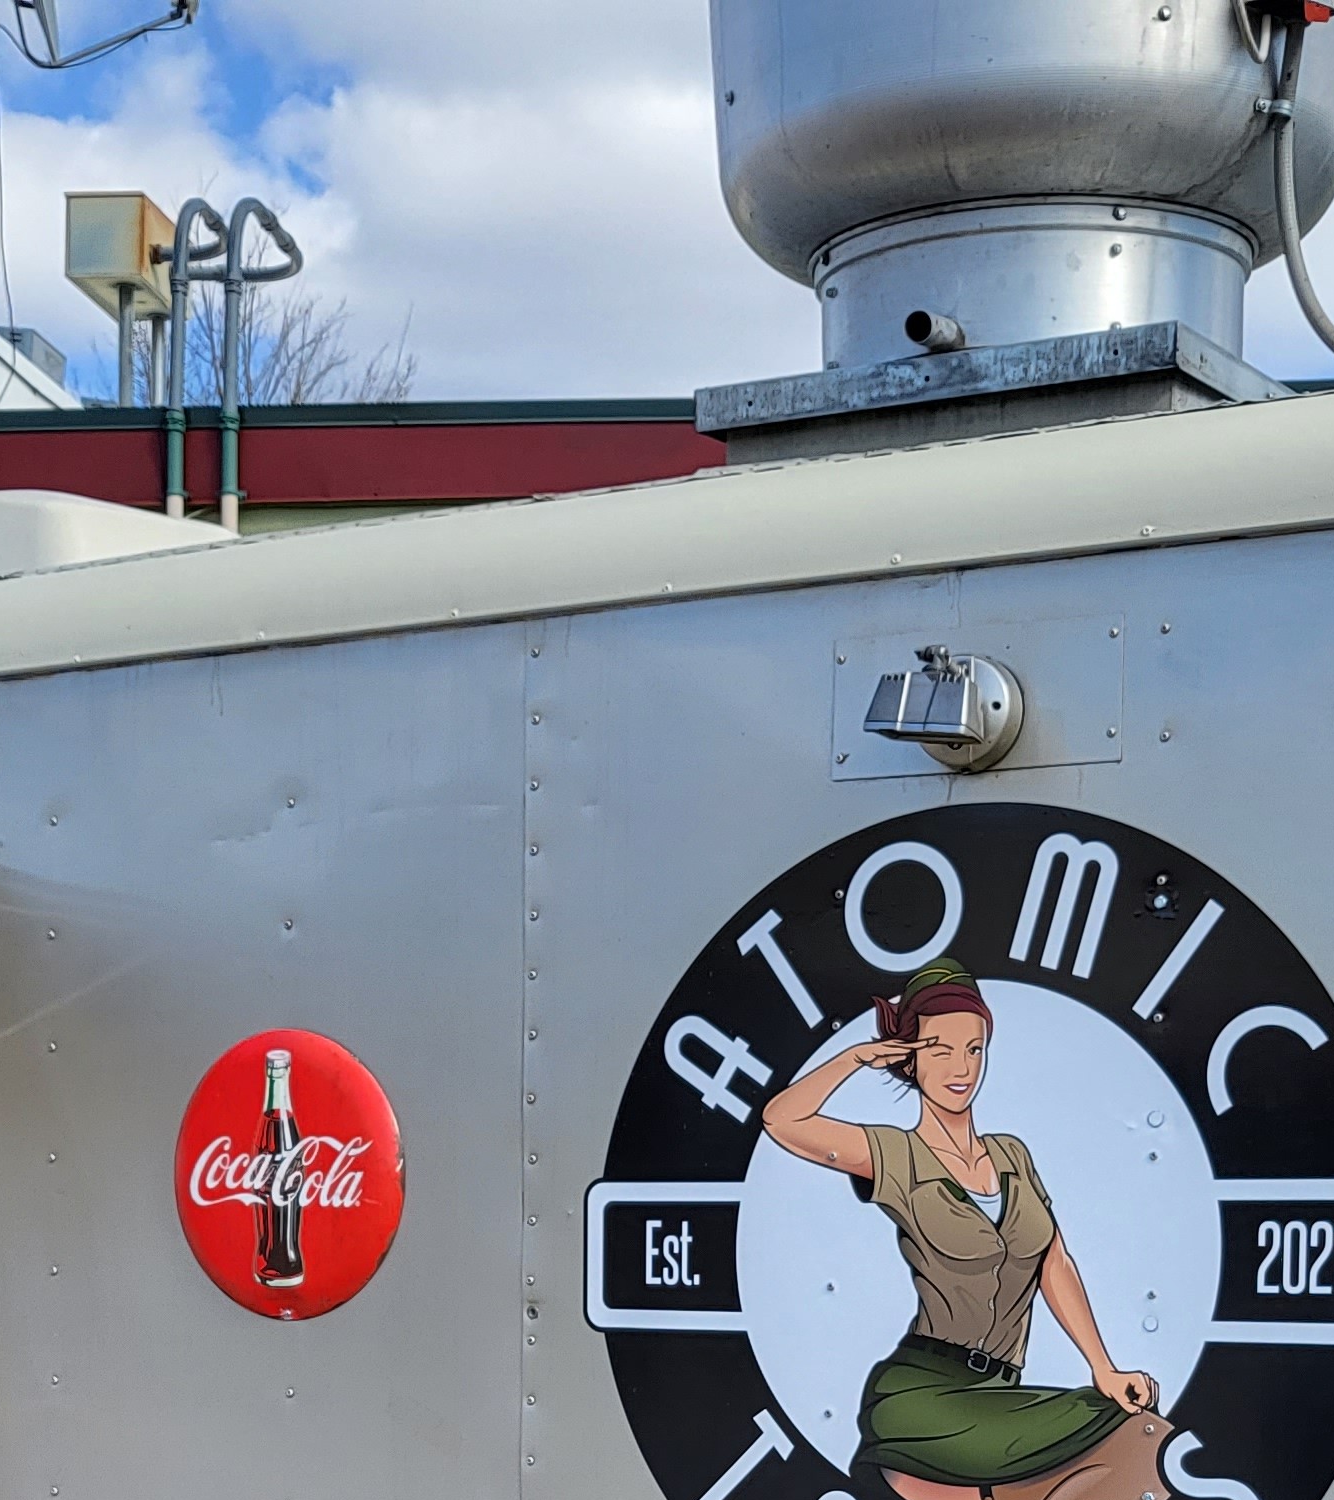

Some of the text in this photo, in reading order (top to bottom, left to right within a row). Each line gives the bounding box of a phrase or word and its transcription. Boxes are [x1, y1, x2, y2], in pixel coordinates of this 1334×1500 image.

[664, 833, 1329, 1124] ATOMIC
[189, 1135, 373, 1208] Coca-Cola
[645, 1219, 700, 1286] Est.
